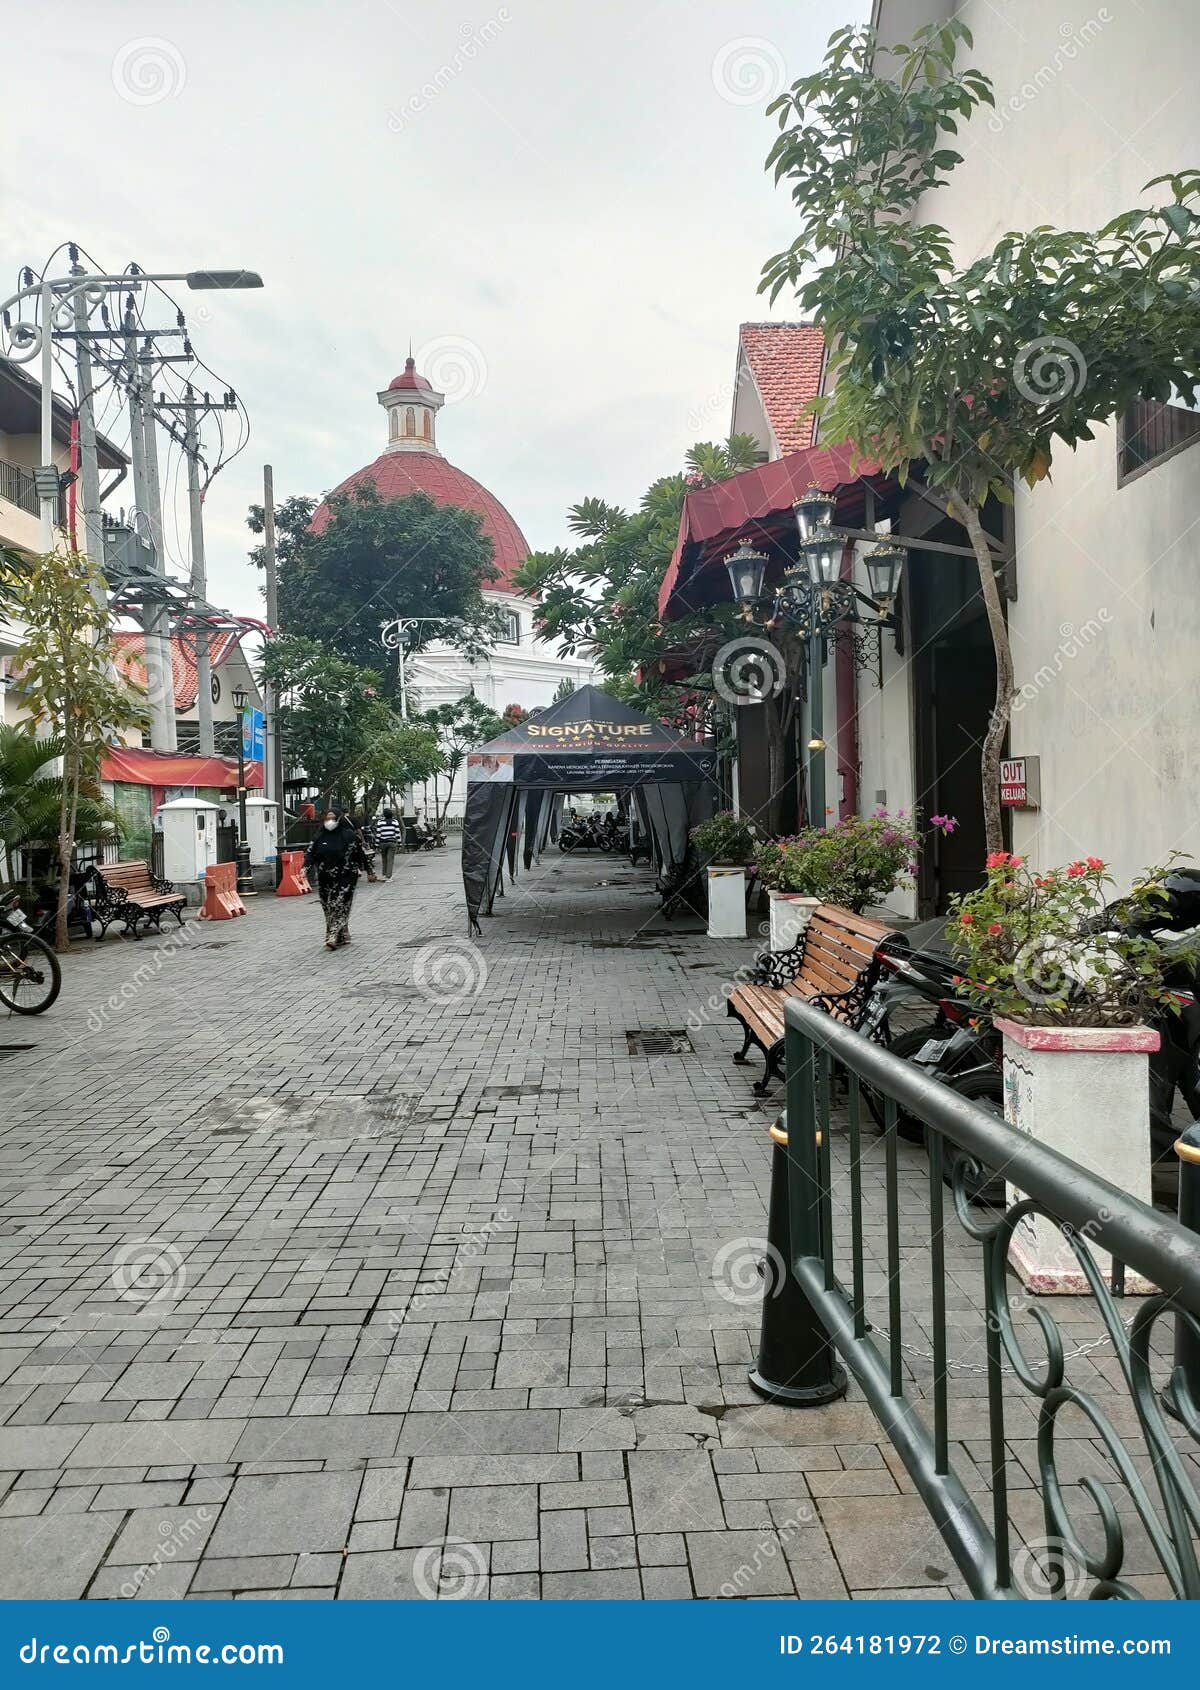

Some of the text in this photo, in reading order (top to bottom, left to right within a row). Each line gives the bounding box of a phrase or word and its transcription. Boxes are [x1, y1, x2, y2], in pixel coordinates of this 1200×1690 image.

[527, 723, 653, 736] SIGNATURE
[1003, 763, 1022, 781] OUT
[1001, 788, 1026, 801] KELUAR
